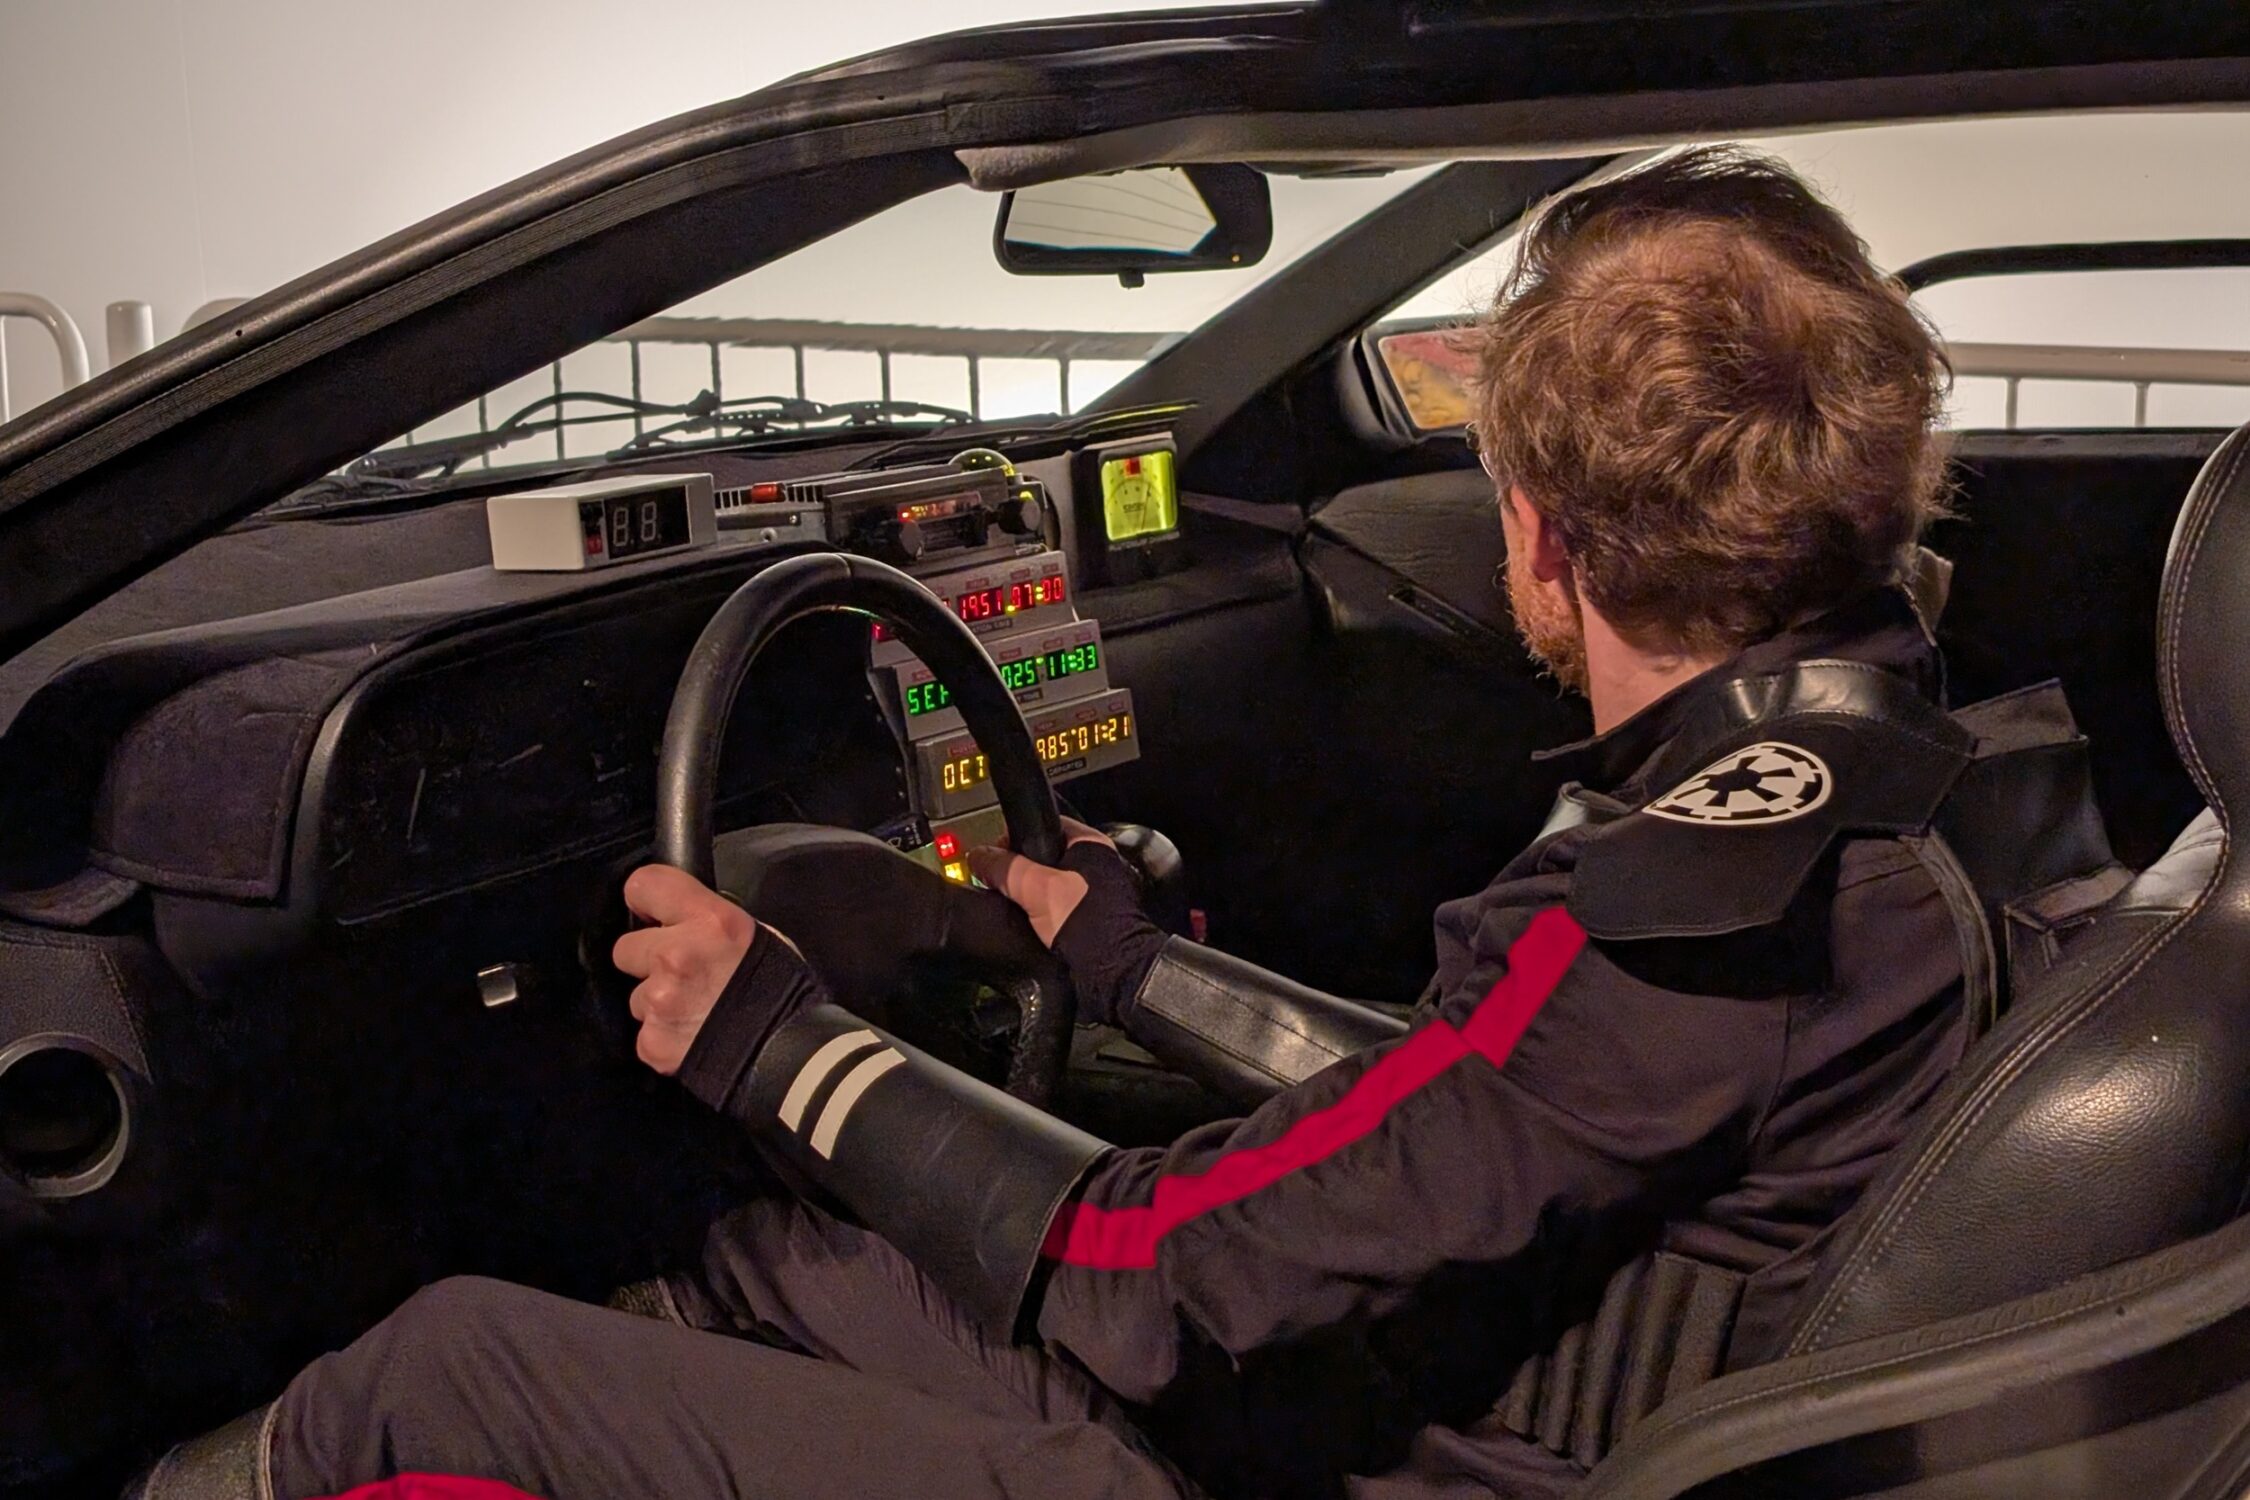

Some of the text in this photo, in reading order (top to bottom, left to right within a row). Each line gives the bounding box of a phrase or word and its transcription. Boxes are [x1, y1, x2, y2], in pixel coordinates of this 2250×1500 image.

[961, 590, 1004, 620] 1951
[1011, 577, 1063, 608] 07:00
[1049, 645, 1097, 677] 11:33
[944, 755, 984, 790] OCT
[1078, 716, 1129, 751] 01:21
